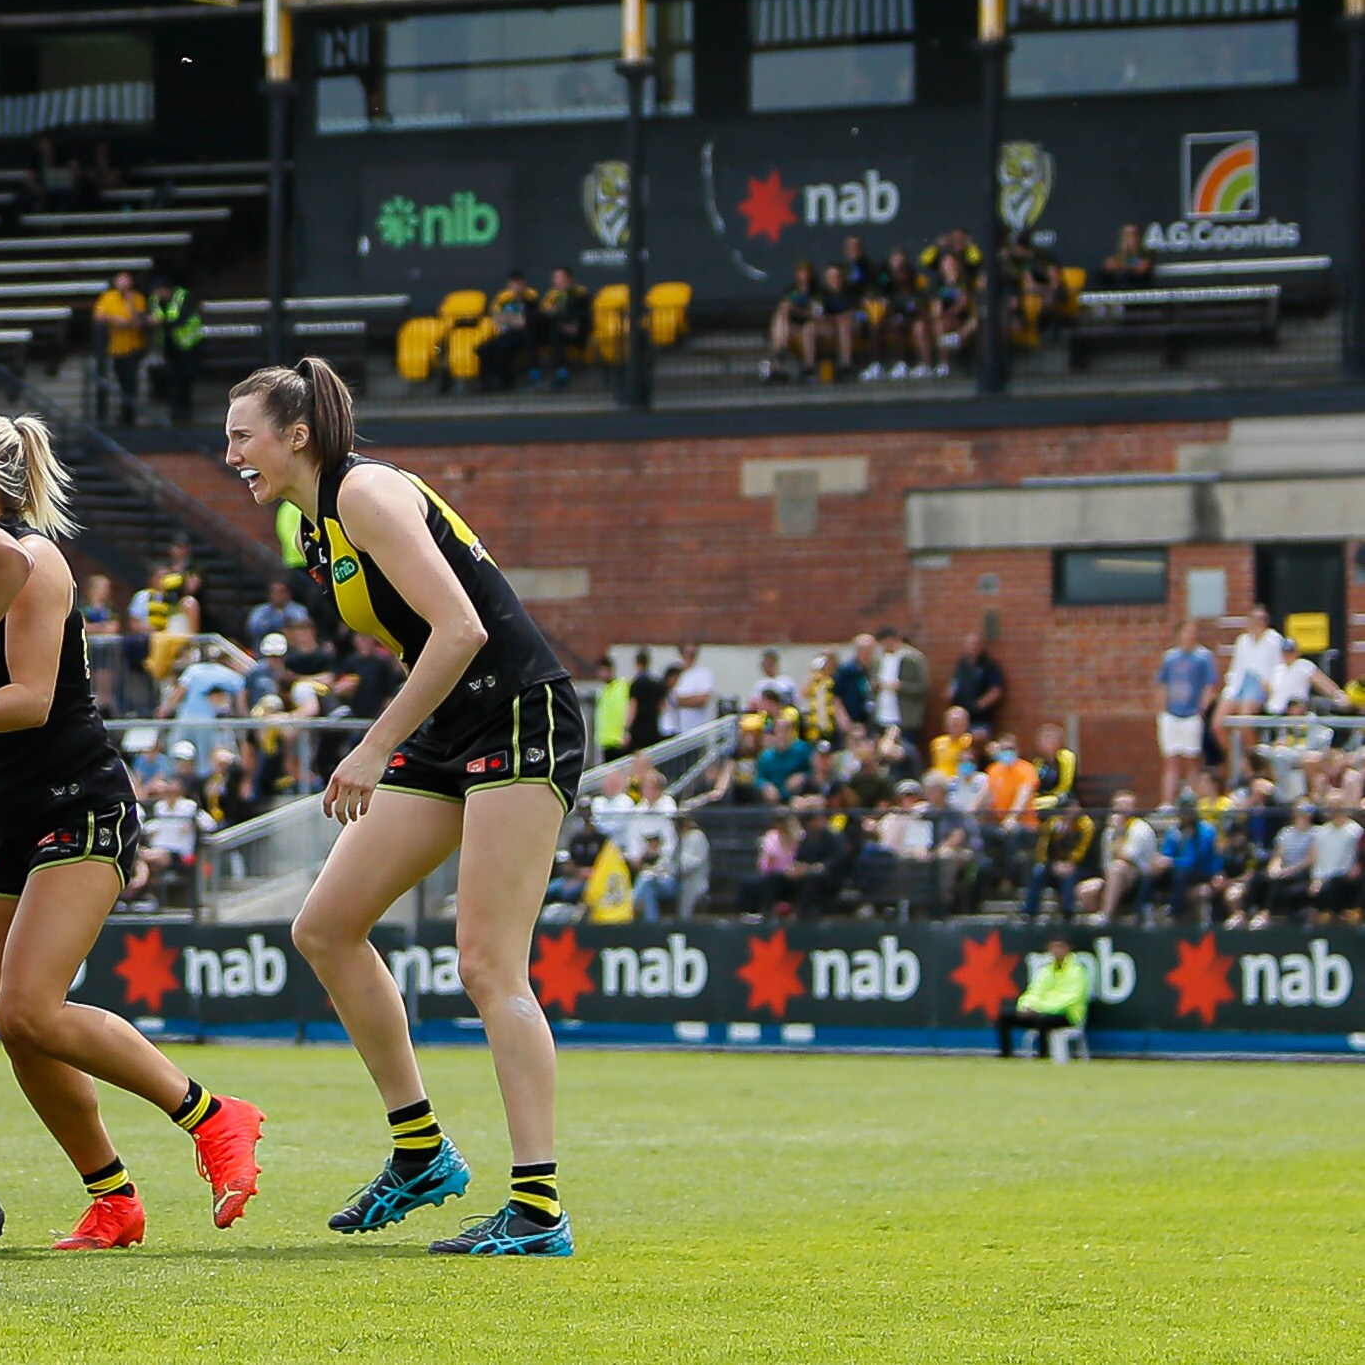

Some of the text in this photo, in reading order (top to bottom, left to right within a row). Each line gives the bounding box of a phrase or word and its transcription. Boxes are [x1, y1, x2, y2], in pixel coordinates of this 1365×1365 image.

[422, 191, 501, 249] nib
[804, 169, 900, 227] nab
[183, 934, 287, 998] nab
[601, 933, 709, 999] nab
[811, 934, 921, 1002] nab
[1240, 938, 1354, 1008] nab
